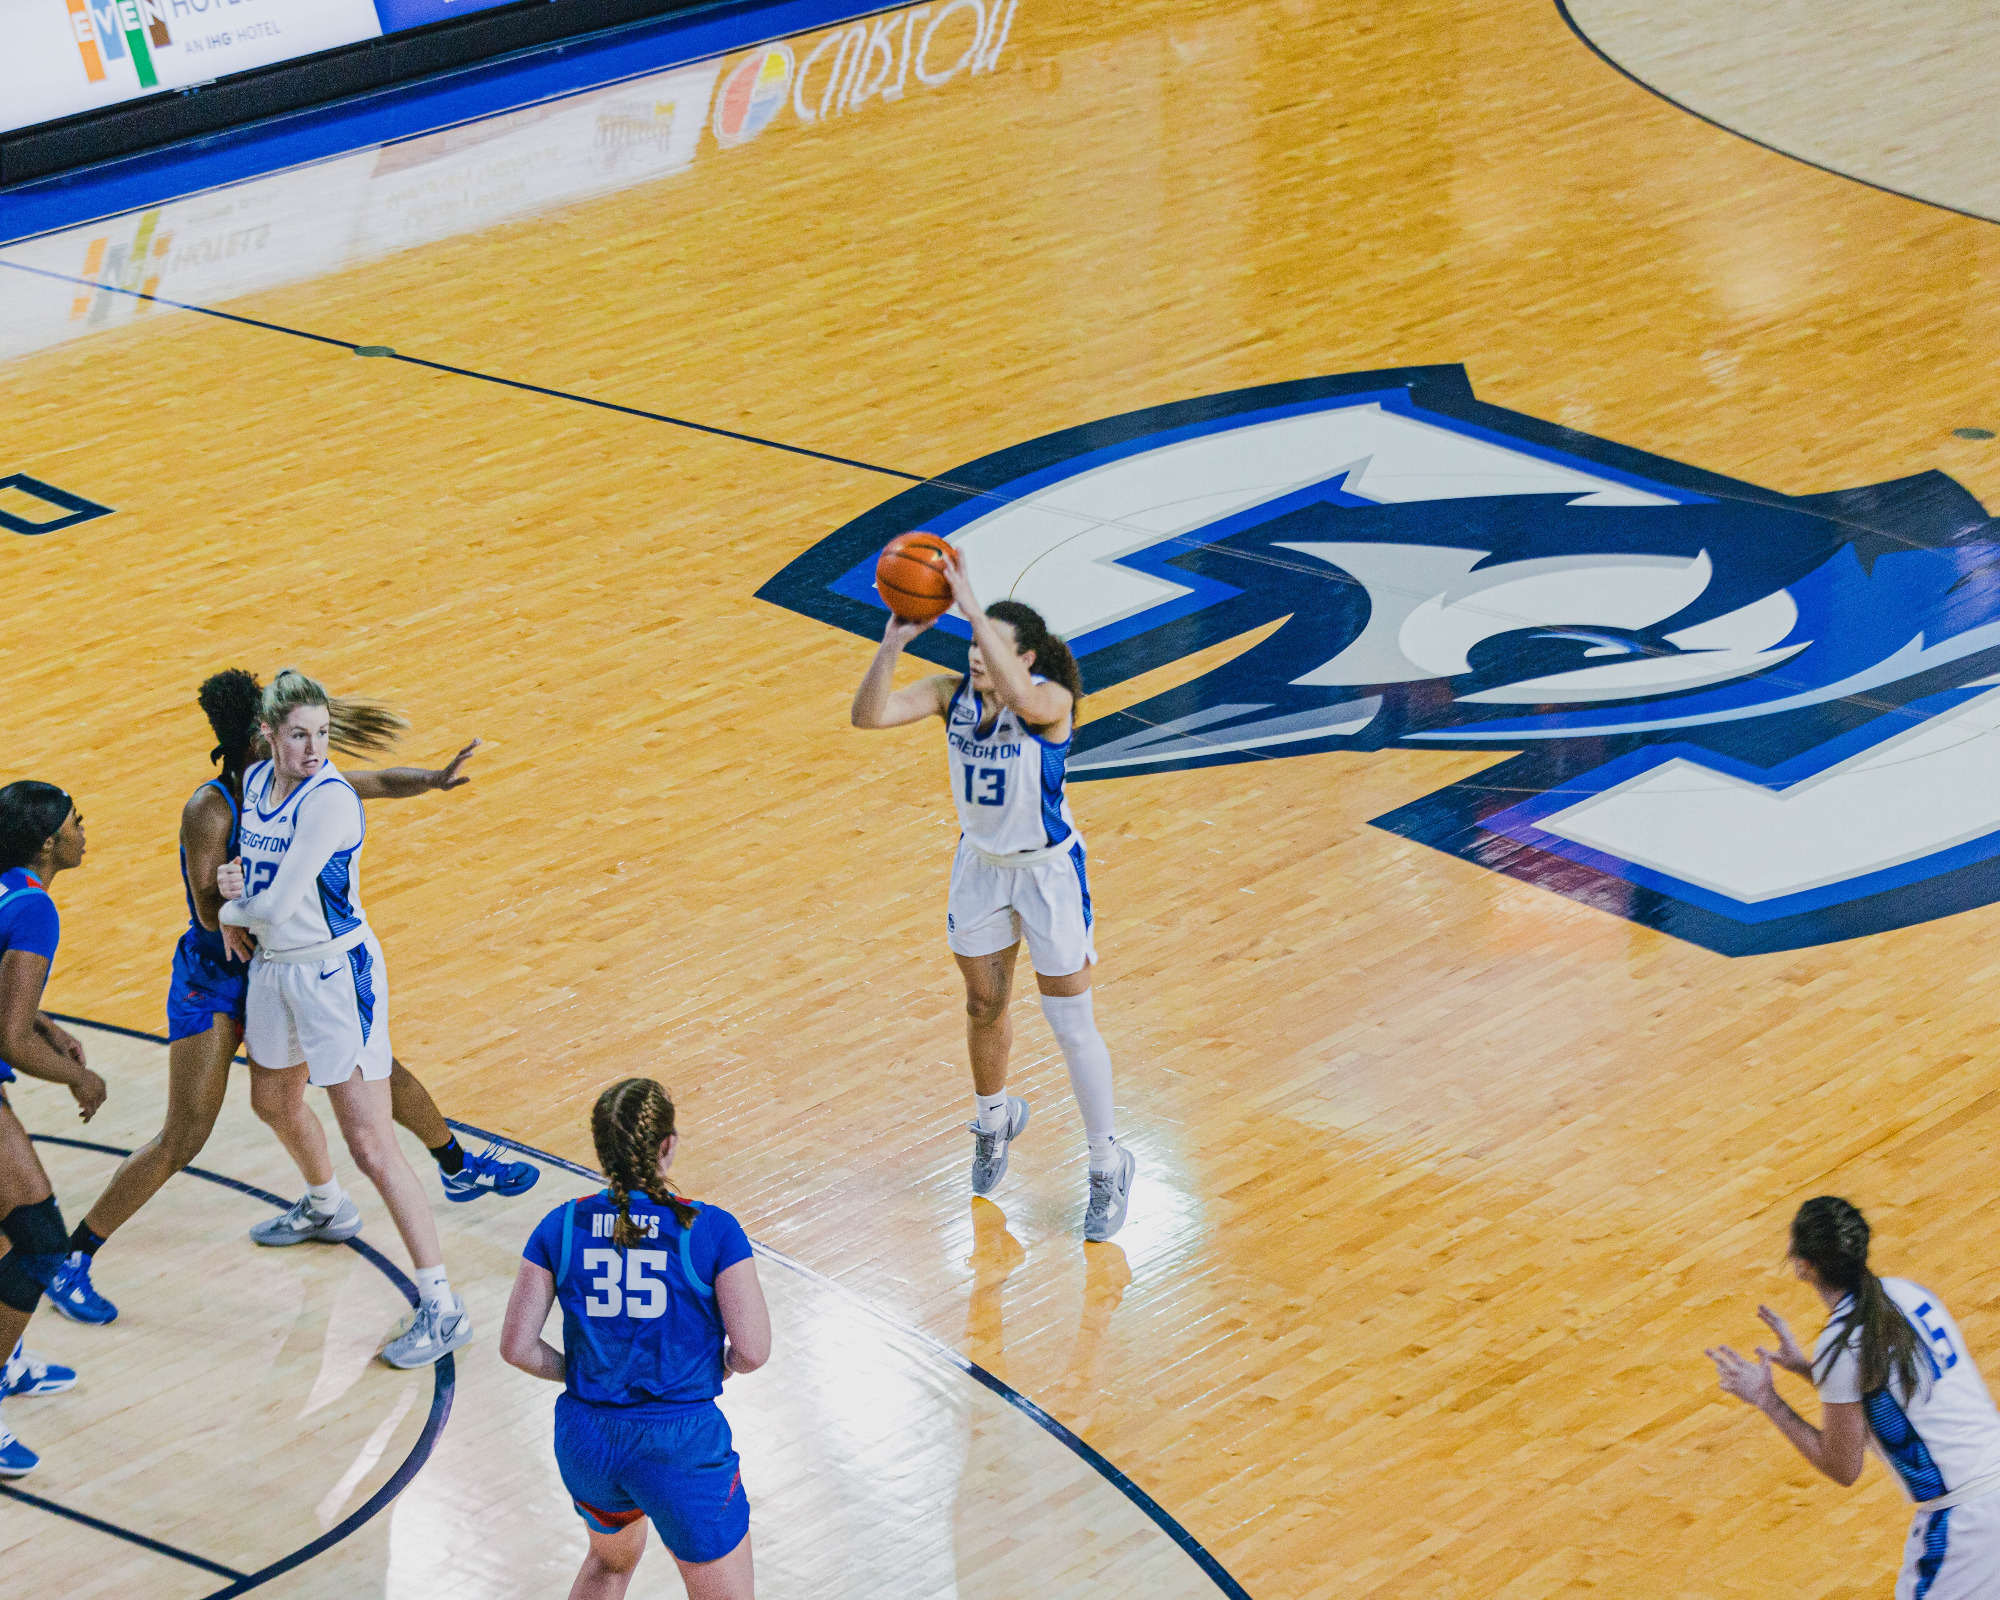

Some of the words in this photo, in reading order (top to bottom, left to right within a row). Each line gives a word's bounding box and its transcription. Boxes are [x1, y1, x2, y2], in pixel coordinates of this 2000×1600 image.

[70, 0, 167, 42] EVEN
[237, 20, 281, 42] HOTEL
[963, 763, 1006, 807] 13
[592, 1213, 660, 1239] HOES
[583, 1248, 668, 1319] 35
